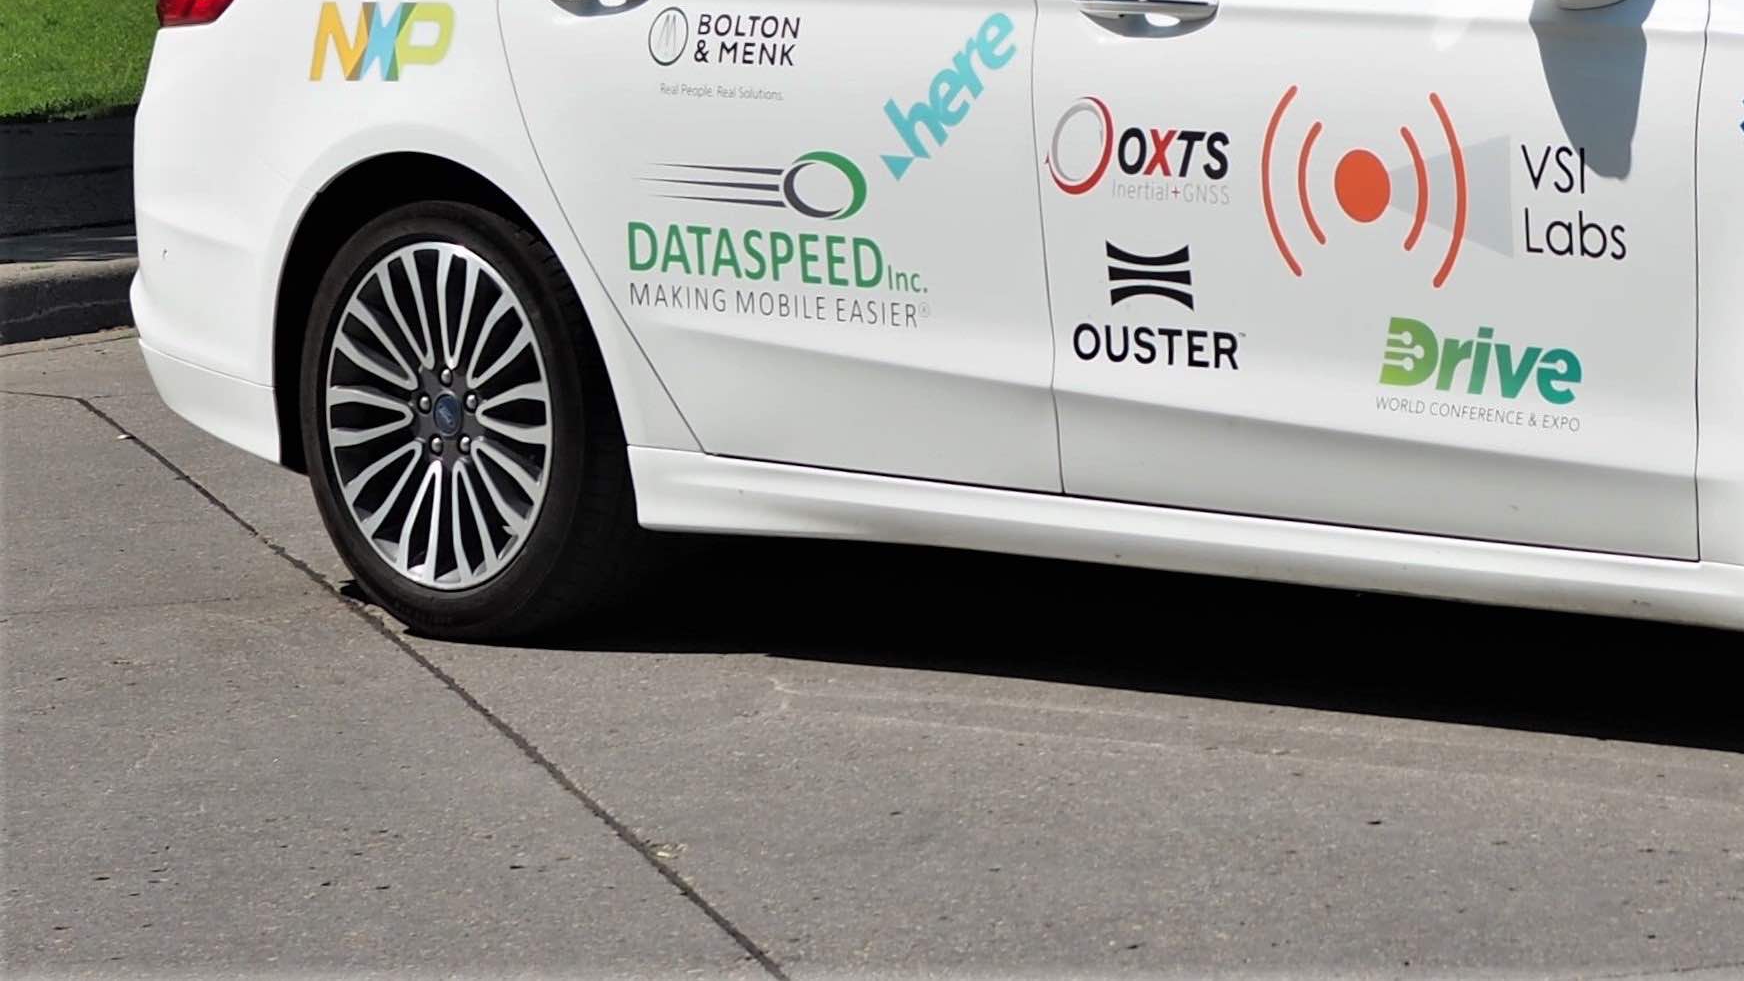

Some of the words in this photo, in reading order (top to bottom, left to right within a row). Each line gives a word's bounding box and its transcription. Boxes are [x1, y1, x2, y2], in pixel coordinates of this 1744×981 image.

[309, 1, 455, 81] NXP
[697, 13, 801, 39] BOLTON
[693, 39, 709, 63] &
[718, 41, 796, 66] MENK
[660, 83, 679, 95] Real
[716, 86, 736, 98] Real
[883, 12, 1017, 160] here
[1117, 126, 1231, 181] OXTS
[1521, 144, 1585, 194] VSI
[627, 221, 884, 289] DATASPEED
[887, 264, 929, 293] Inc.
[1524, 207, 1627, 260] Labs
[629, 282, 727, 313] MAKING
[736, 289, 826, 321] MOBILE
[1378, 316, 1582, 406] Drive
[1376, 396, 1426, 415] WORLD
[1430, 401, 1524, 427] CONFERENCE
[1528, 412, 1538, 428] &
[1542, 413, 1581, 432] EXPO
